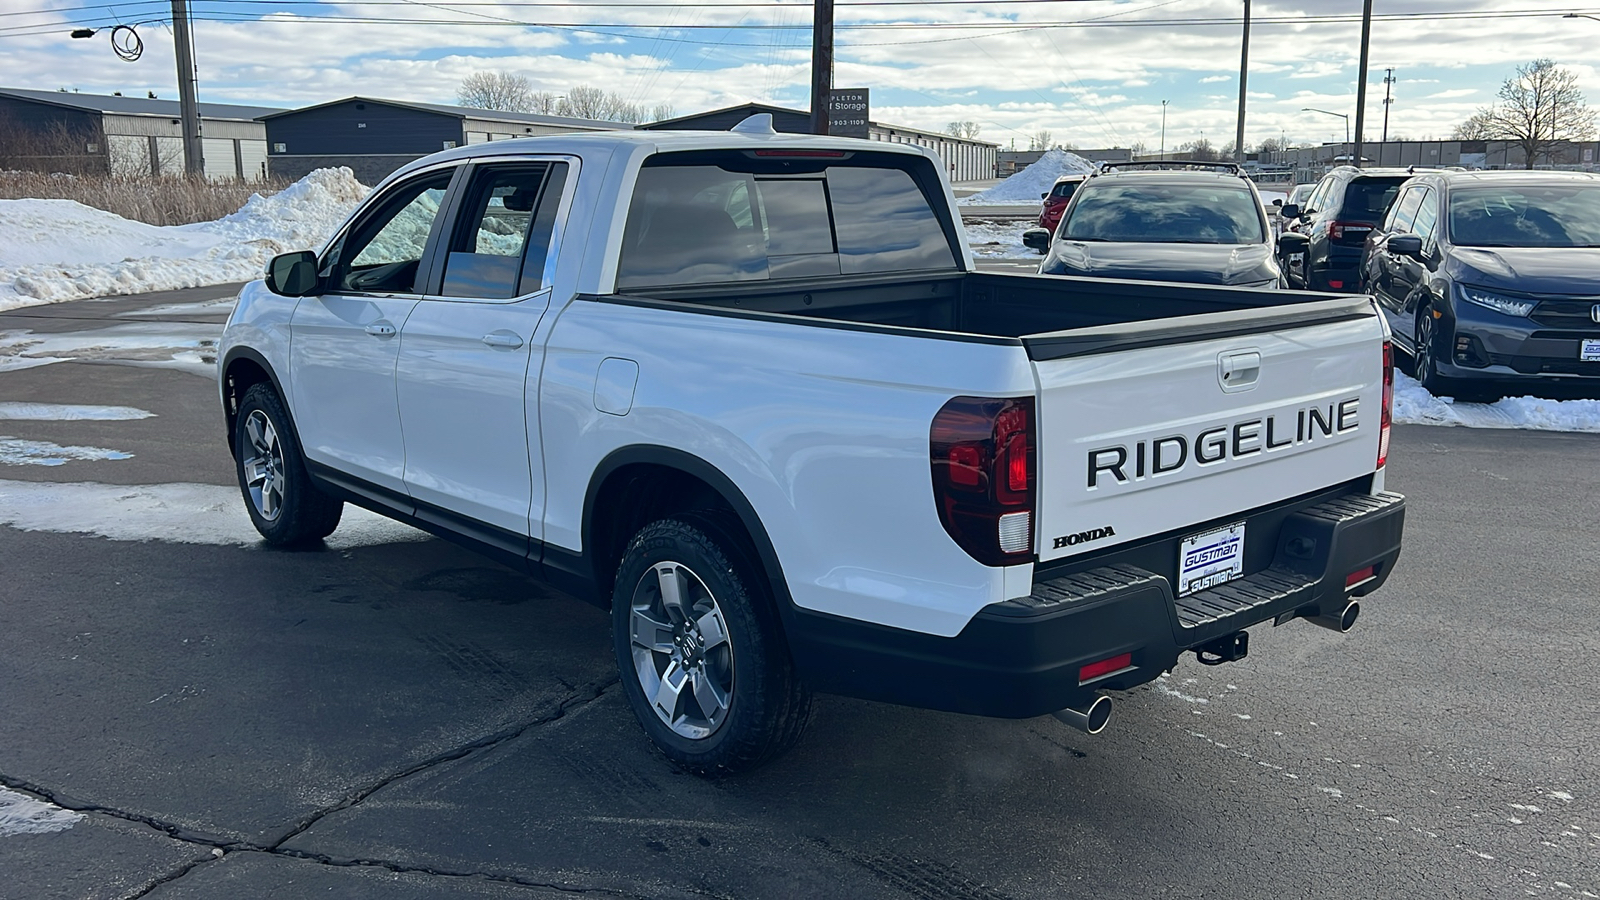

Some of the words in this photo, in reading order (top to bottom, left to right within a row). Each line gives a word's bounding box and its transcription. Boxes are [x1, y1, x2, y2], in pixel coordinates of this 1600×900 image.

[835, 102, 866, 111] Storage
[1087, 398, 1360, 489] RIDGELINE
[1053, 525, 1116, 549] HONDA
